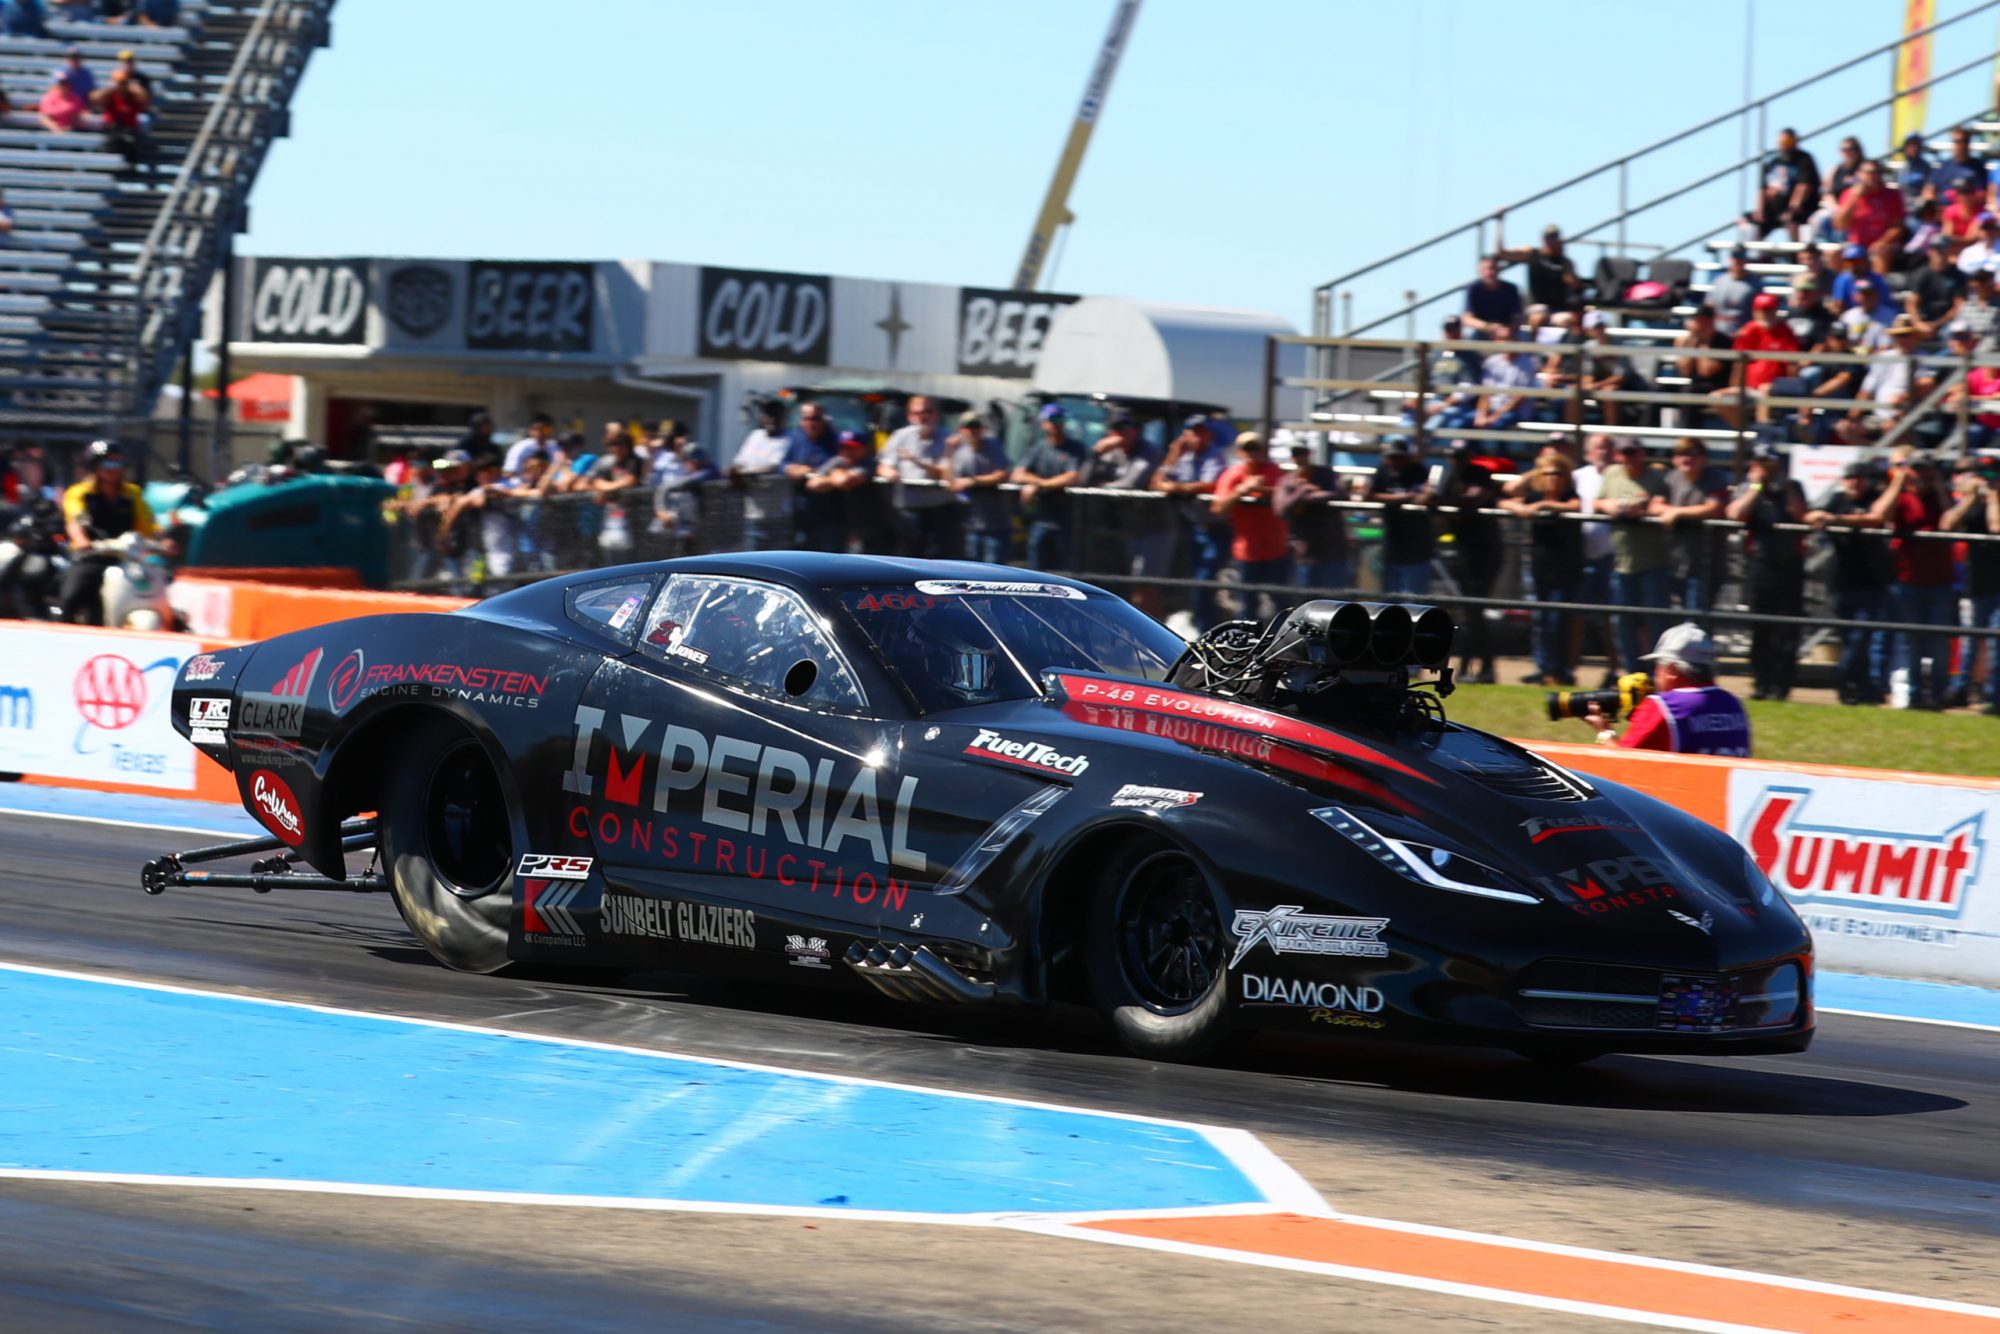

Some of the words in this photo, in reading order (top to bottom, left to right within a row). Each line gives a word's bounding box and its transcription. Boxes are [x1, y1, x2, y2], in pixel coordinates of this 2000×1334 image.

[255, 265, 364, 335] COLD
[471, 270, 589, 340] BEER
[704, 278, 827, 354] COLD
[360, 684, 420, 699] ENGINE
[431, 685, 540, 709] DYNAMICS
[364, 663, 549, 696] FRANKENSTEIN
[241, 701, 302, 731] CLARK
[1081, 684, 1136, 702] P-48
[1144, 693, 1277, 730] EVOLUTION
[968, 728, 1090, 777] FuelTech
[562, 704, 927, 873] IMPERIAL
[518, 854, 592, 875] PRS
[569, 806, 910, 912] CONSTRUCTION
[573, 936, 586, 947] LLC
[600, 893, 672, 938] SUNBELT
[677, 900, 756, 949] GLAZIERS
[1241, 973, 1385, 1013] DIAMOND
[1310, 1010, 1384, 1029] Pistons
